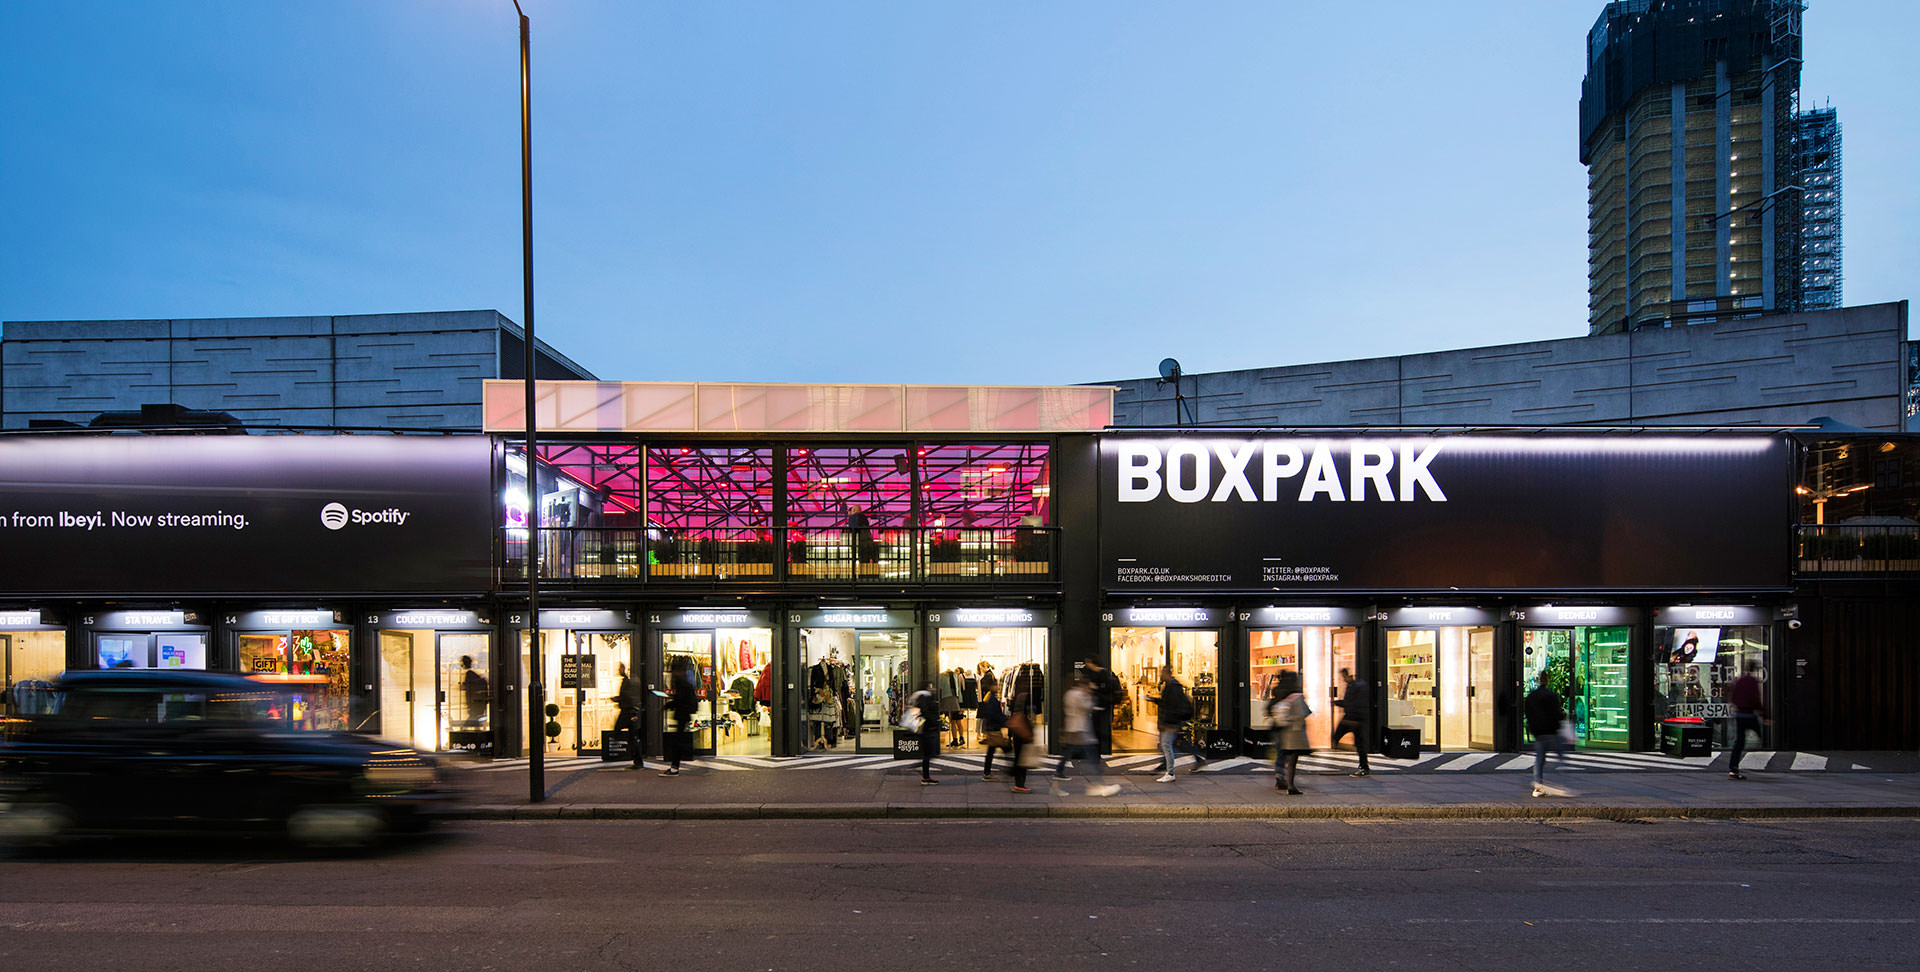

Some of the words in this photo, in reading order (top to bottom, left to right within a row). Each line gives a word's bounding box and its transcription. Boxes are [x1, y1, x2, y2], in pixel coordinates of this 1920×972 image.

[1118, 442, 1447, 503] BOXPARK
[12, 511, 54, 527] from
[59, 511, 106, 530] Ibeyi.
[111, 511, 152, 527] Now
[157, 510, 249, 529] streaming.
[351, 508, 407, 525] Spotify
[1117, 567, 1170, 575] BOXPARK.CO.UK
[1263, 566, 1294, 574] TWITTER:
[1294, 566, 1330, 574] @BOXPARK
[1117, 575, 1154, 583] FACEBOOK:
[1154, 574, 1232, 583] @BOXPARKSHOREDITCH
[1263, 574, 1303, 582] INSTAGRAM:
[1303, 574, 1339, 582] @BOXPARK
[510, 615, 521, 623] 12
[650, 615, 661, 623] 11
[682, 614, 715, 623] NORDIC
[715, 614, 747, 623] POETRY
[790, 614, 800, 623] 10
[823, 614, 852, 623] SUGAR
[861, 614, 888, 623] STYLE
[929, 614, 940, 622] 09
[956, 613, 1005, 622] WANDERING
[1006, 613, 1033, 622] MINDS
[1102, 613, 1114, 621] 08
[1129, 612, 1164, 621] CAMDEN
[1164, 612, 1193, 621] WATCH
[1194, 612, 1209, 621] CO.
[1240, 612, 1251, 621] 07
[1274, 612, 1331, 621] PAPERSMITHS
[1377, 612, 1388, 620] 06
[1429, 611, 1452, 620] HYPE
[1558, 611, 1597, 620] BEDHEAD
[1695, 610, 1735, 619] BEDHEAD
[7, 616, 32, 625] EIGHT
[83, 616, 94, 625] 15
[125, 615, 139, 625] STA
[140, 615, 173, 625] TRAVEL
[225, 616, 237, 624] 14
[263, 615, 280, 624] THE
[281, 615, 300, 624] GIFT
[301, 615, 319, 624] BOX
[368, 616, 379, 624] 13
[396, 615, 424, 624] COUCO
[426, 615, 467, 624] EYEWEAR
[255, 660, 274, 668] GIFT
[1709, 664, 1768, 684] HED
[1677, 703, 1704, 717] HAIR
